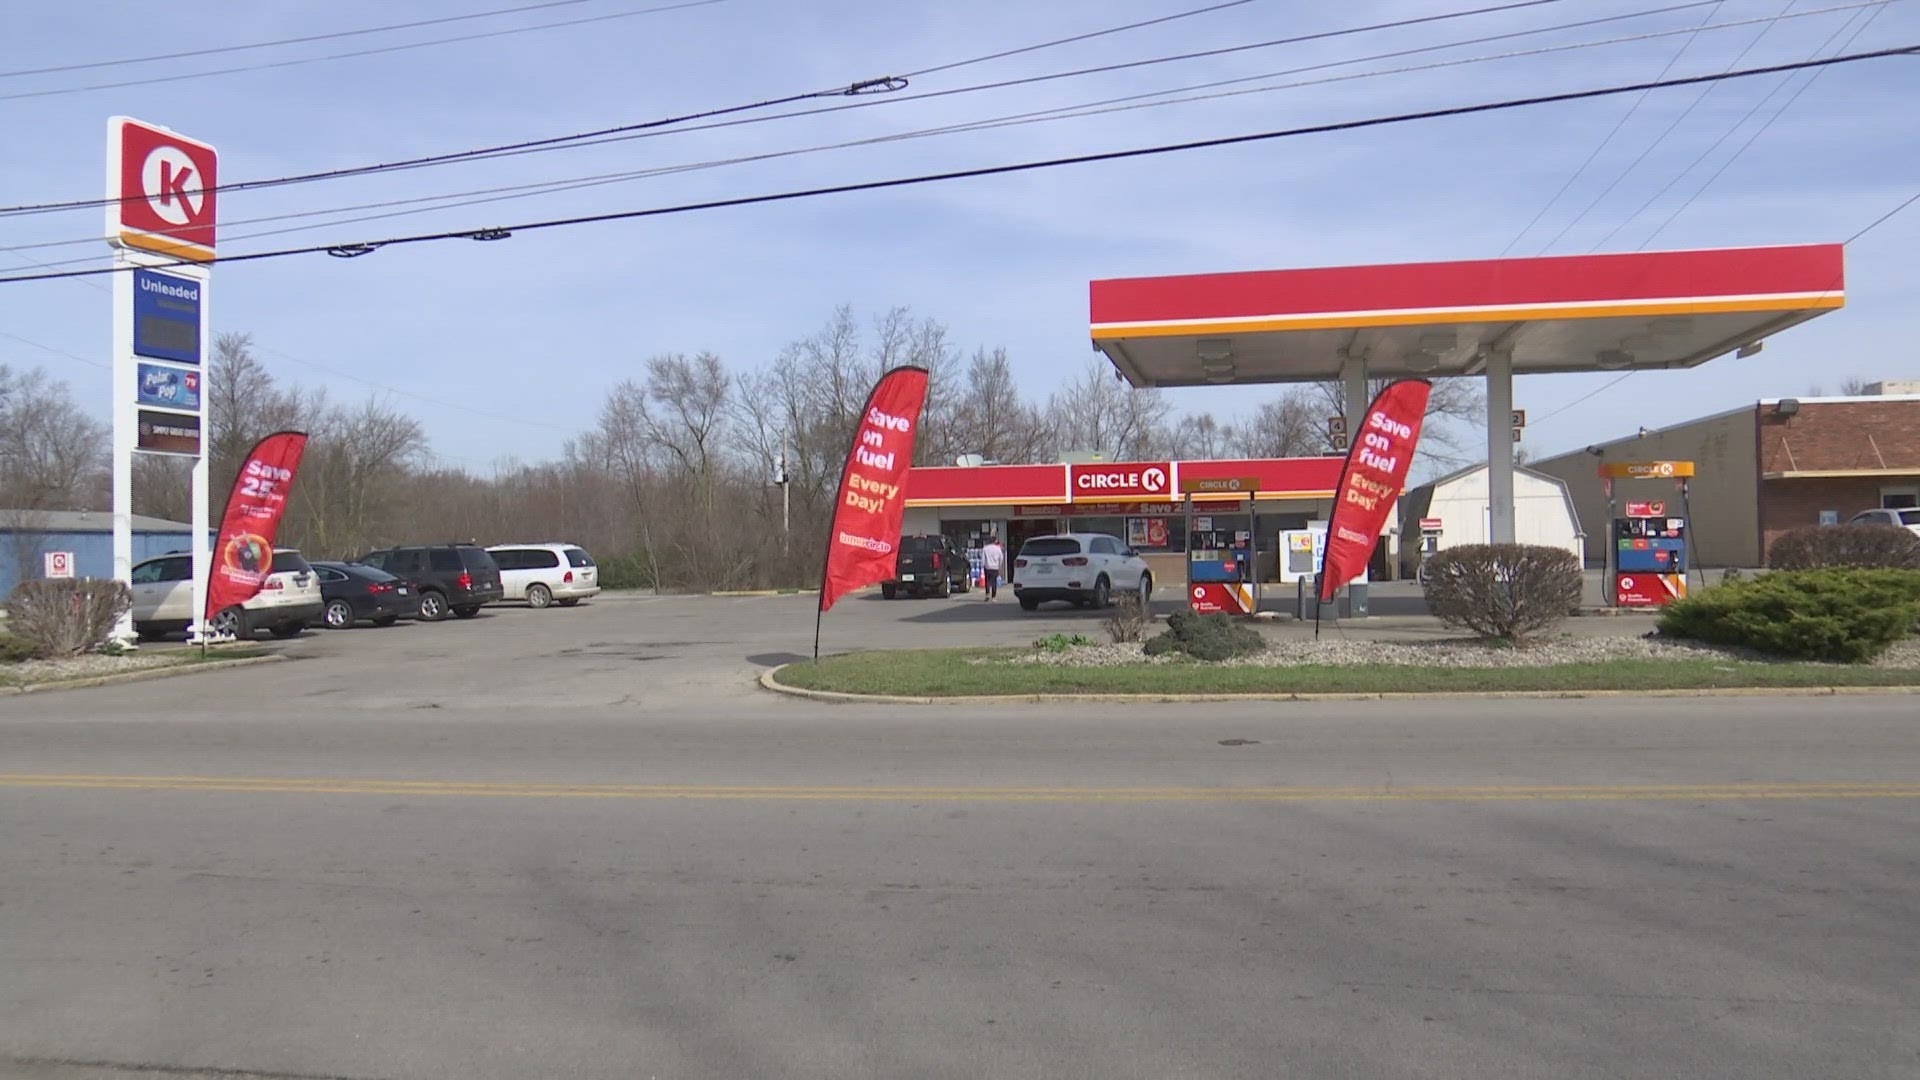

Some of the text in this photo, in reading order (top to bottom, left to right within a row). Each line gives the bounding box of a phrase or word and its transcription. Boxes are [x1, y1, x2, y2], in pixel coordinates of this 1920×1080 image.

[140, 278, 198, 301] Unleaded
[145, 370, 171, 387] Polar
[158, 385, 177, 400] Pop
[868, 406, 910, 432] Save
[1370, 411, 1411, 438] Save
[863, 429, 883, 448] on
[1365, 432, 1389, 450] on
[856, 445, 895, 471] fuel
[1359, 448, 1396, 473] fuel
[247, 459, 291, 482] Save
[1078, 469, 1164, 491] CIRCLE K
[1628, 463, 1672, 476] CIRCLE K
[848, 473, 899, 499] Every
[1200, 479, 1240, 490] CIRCLE K
[1350, 472, 1393, 498] Every
[845, 490, 884, 514] Day!
[1140, 502, 1171, 515] Save
[1346, 489, 1378, 511] Day!
[1194, 587, 1205, 598] K
[1622, 577, 1633, 589] K
